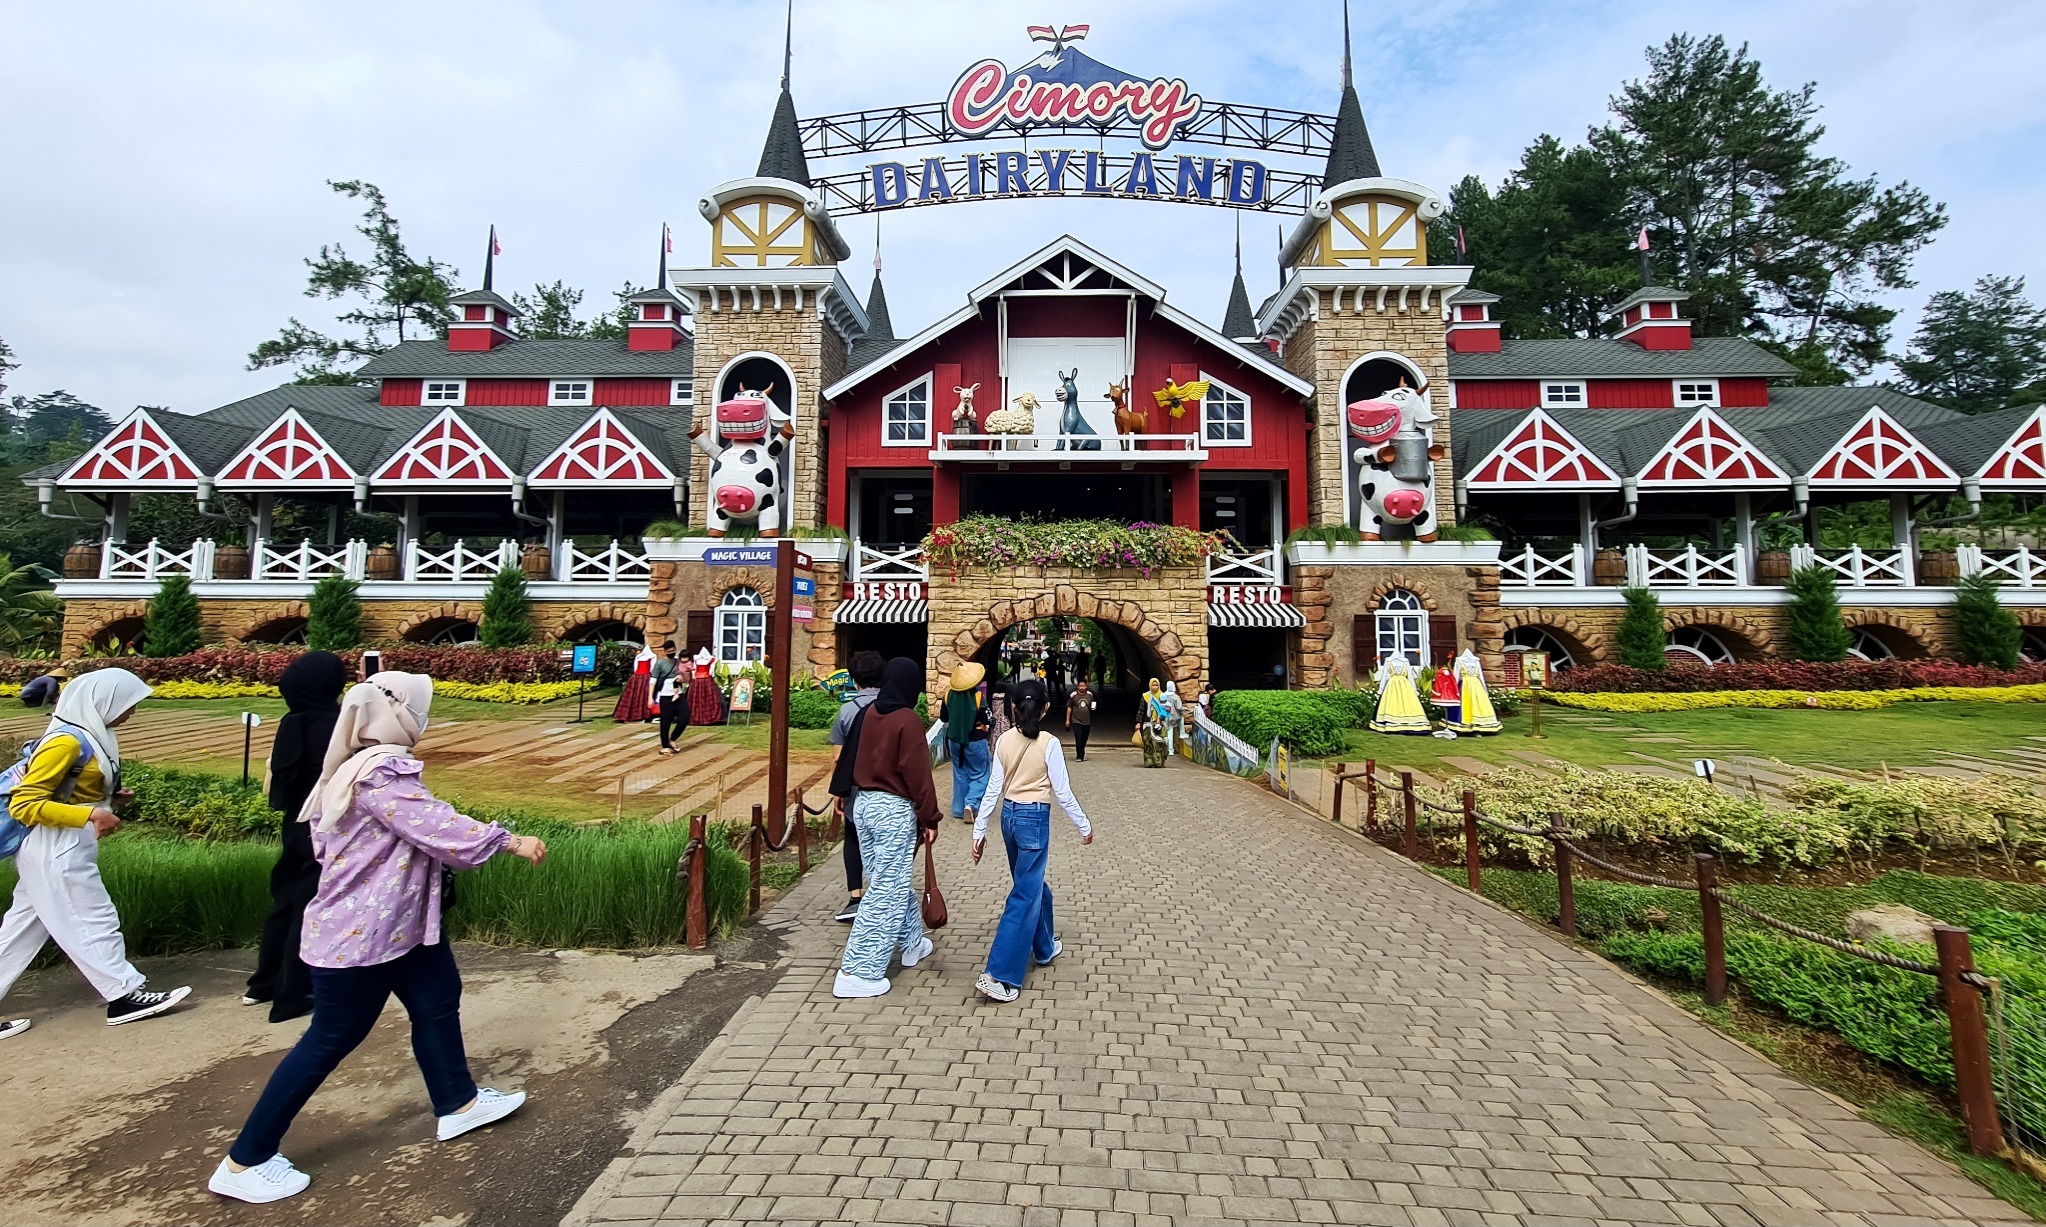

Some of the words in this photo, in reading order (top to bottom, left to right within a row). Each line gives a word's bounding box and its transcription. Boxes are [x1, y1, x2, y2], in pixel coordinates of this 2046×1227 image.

[947, 59, 1202, 148] Cimory
[866, 149, 1269, 210] DAIRYLAND
[711, 551, 738, 561] MAGIC
[739, 551, 772, 561] VILLAGE
[853, 582, 921, 601] RESTO
[1213, 586, 1282, 605] RESTO
[826, 675, 849, 690] Magic
